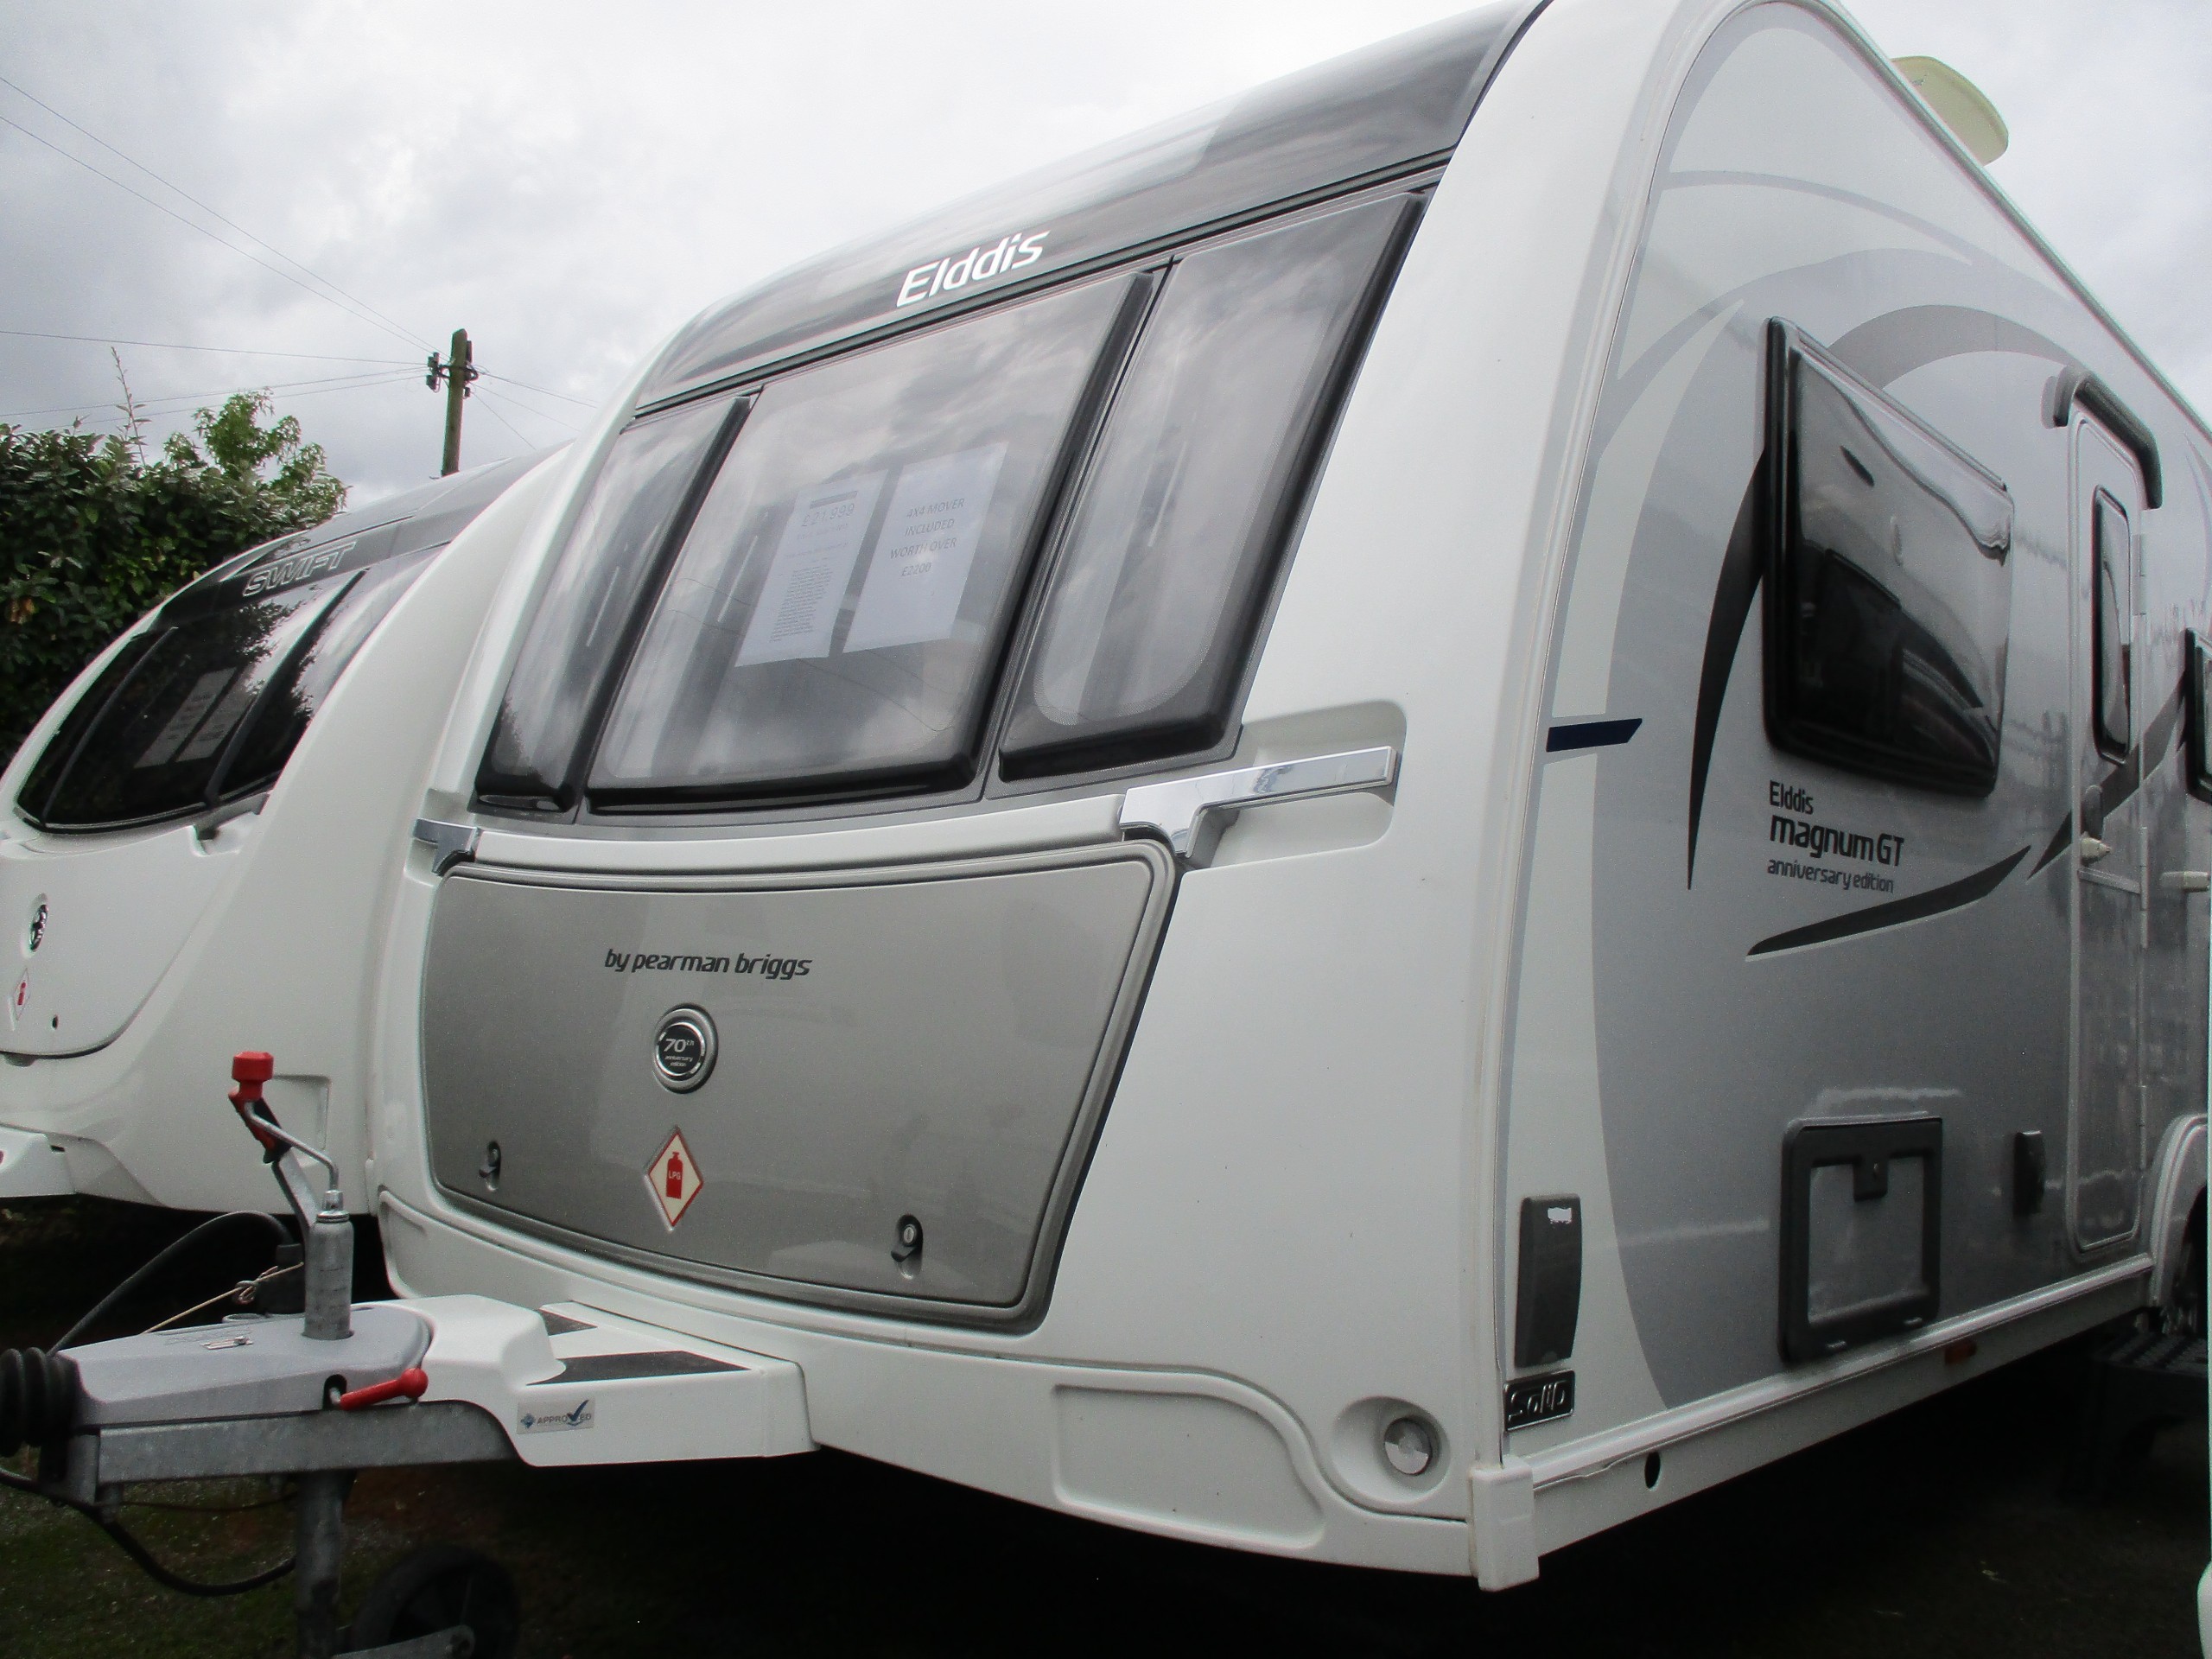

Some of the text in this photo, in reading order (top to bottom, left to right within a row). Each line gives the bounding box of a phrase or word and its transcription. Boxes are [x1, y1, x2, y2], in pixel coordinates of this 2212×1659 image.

[897, 230, 1051, 307] Elddis
[927, 498, 965, 515] MOVER
[905, 518, 956, 537] INCLUDED
[891, 537, 957, 560] WORTH OVER
[243, 540, 357, 597] SWIFT
[1769, 779, 1814, 815] Elddis
[1767, 859, 1894, 893] anniversary edition
[604, 948, 813, 980] by pearman briggs
[668, 1170, 681, 1180] LPG
